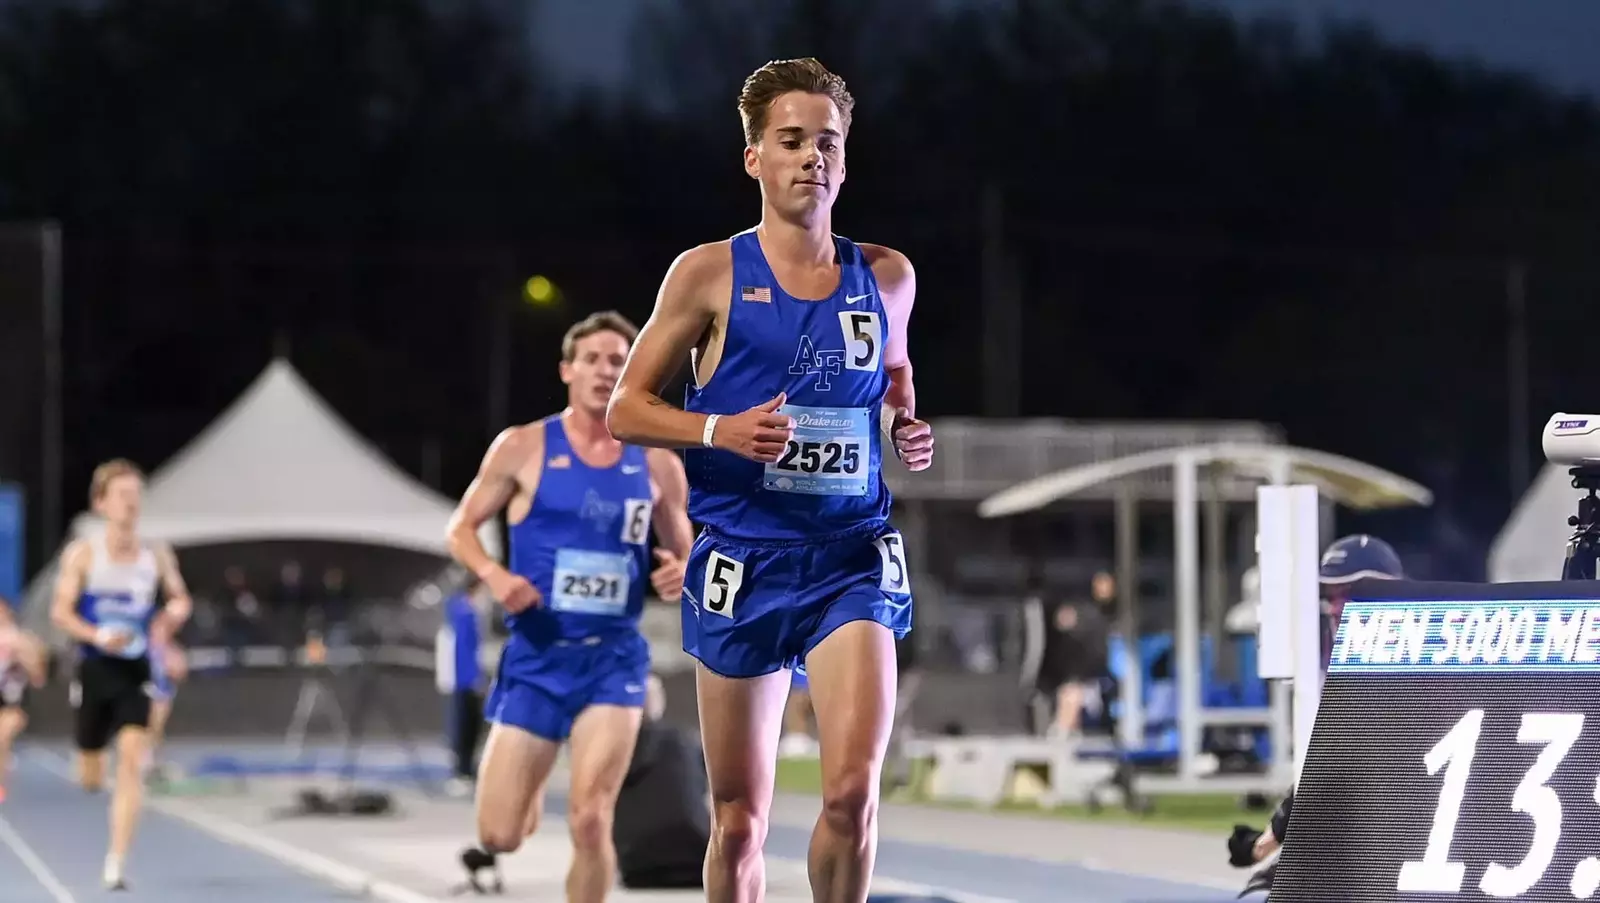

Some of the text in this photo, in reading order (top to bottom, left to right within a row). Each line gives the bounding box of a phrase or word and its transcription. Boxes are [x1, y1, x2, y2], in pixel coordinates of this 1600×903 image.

[789, 335, 846, 391] AF
[850, 314, 875, 367] 5
[798, 413, 831, 427] Drake
[777, 440, 860, 475] 2525
[629, 504, 646, 540] 6
[562, 575, 619, 599] 2521
[708, 557, 735, 612] 5
[881, 537, 904, 590] 5
[1339, 608, 1430, 663] MEN
[1431, 607, 1535, 663] 5000
